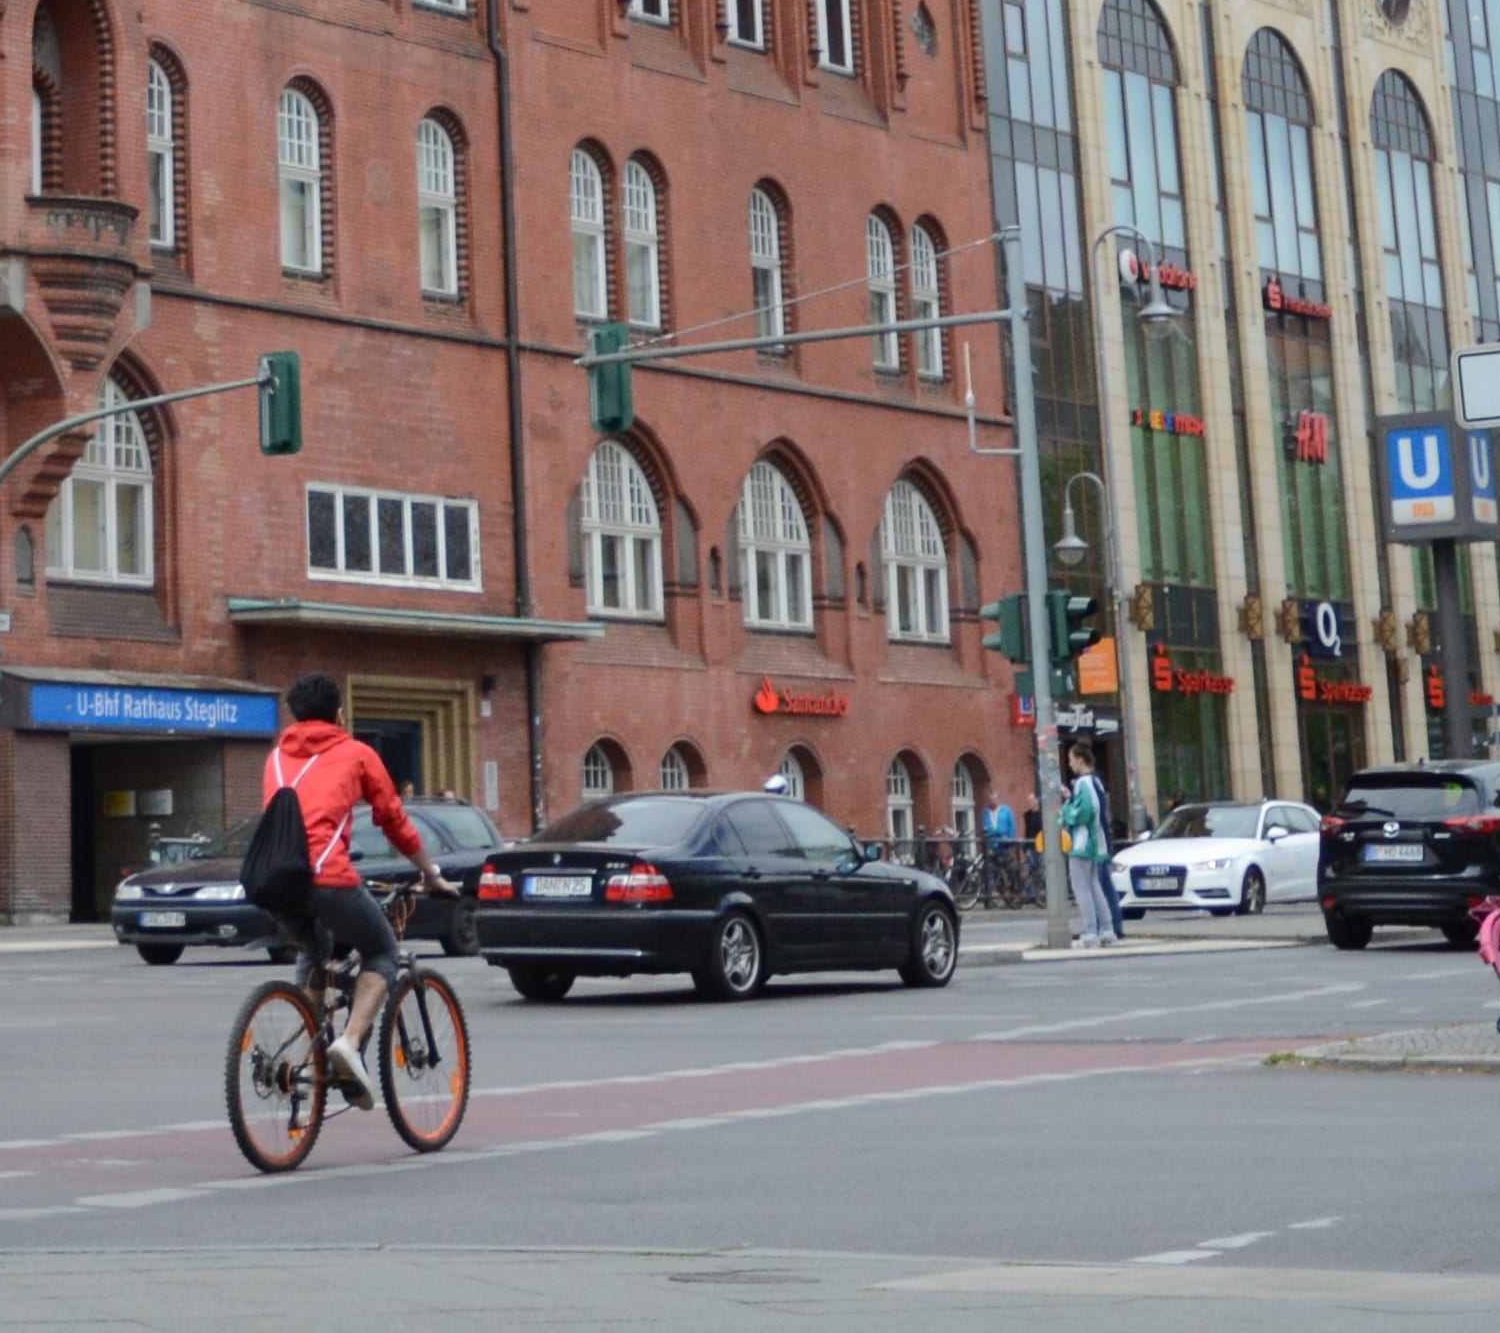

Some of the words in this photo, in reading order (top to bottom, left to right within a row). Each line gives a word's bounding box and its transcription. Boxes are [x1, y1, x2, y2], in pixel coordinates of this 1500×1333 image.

[1397, 435, 1441, 489] U
[1469, 436, 1490, 490] U
[783, 683, 852, 716] Santander
[1176, 667, 1236, 698] Sparkasse
[1319, 677, 1373, 707] Sparkasse
[77, 692, 120, 718] U-Bhf
[124, 694, 182, 721] Rathaus
[185, 696, 238, 728] Steglitz
